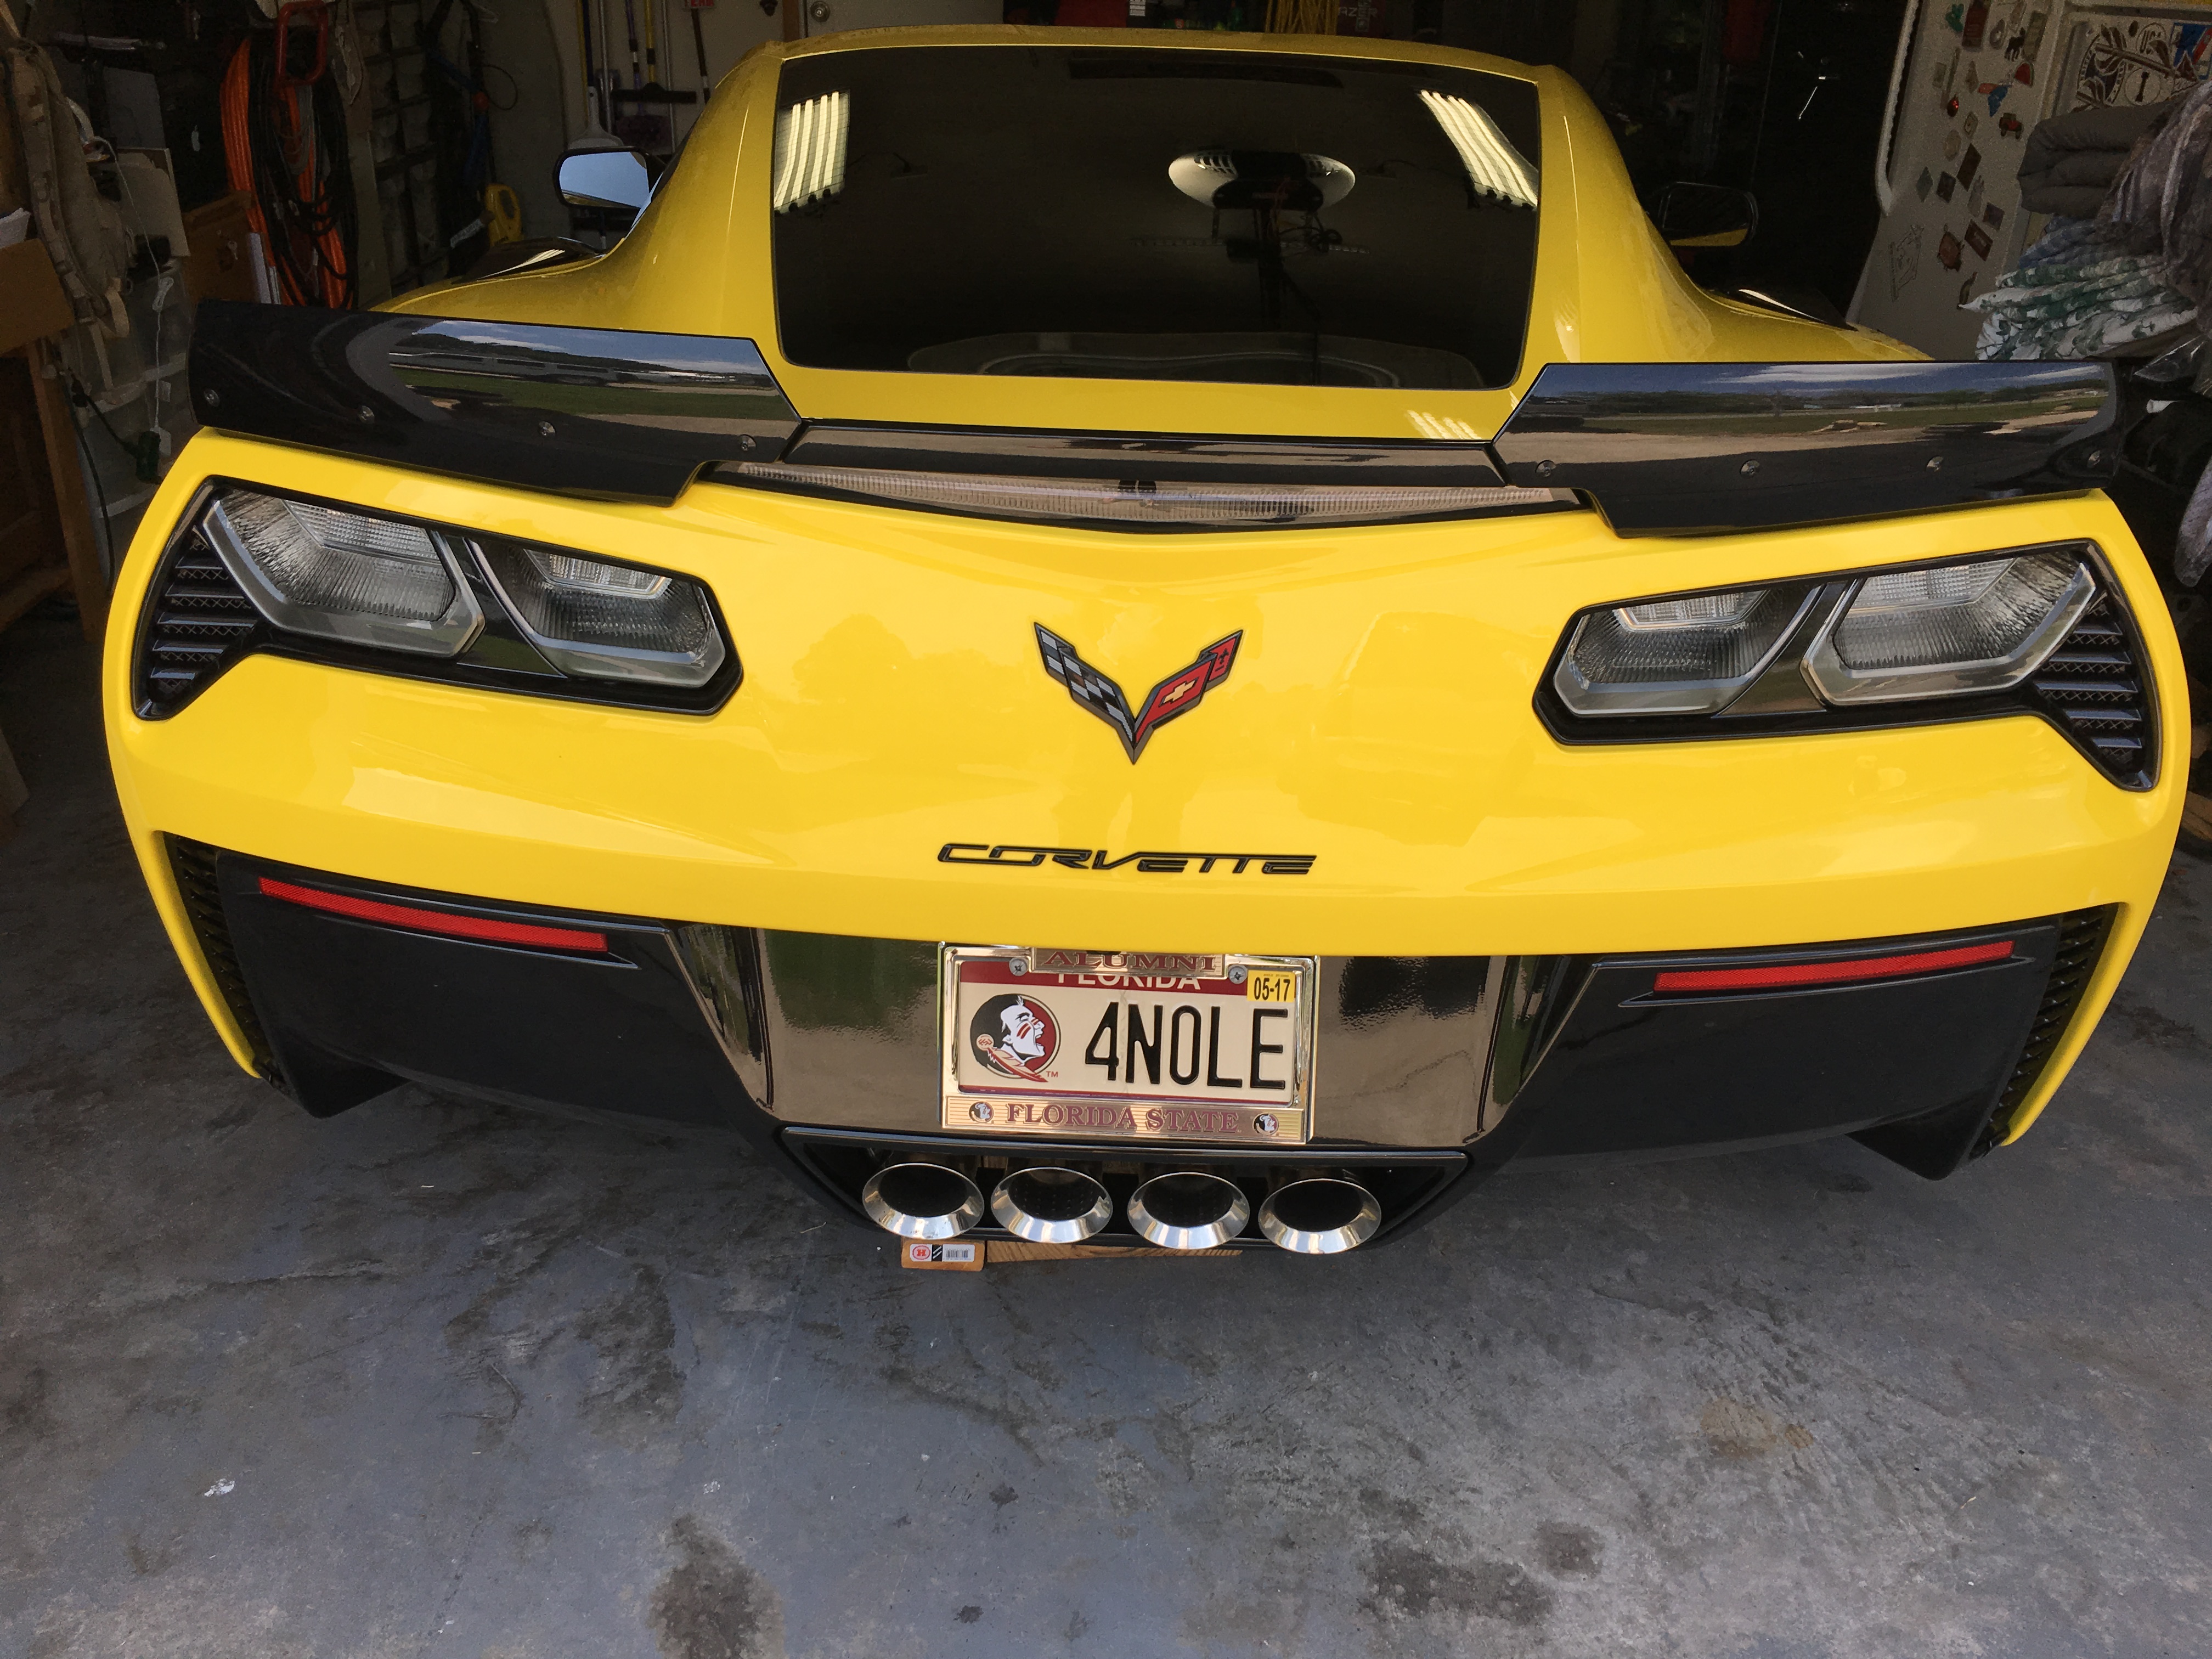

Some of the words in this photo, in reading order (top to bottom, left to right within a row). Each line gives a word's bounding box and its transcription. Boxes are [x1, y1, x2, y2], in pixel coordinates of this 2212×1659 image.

[1338, 7, 1378, 18] AZER
[938, 843, 1317, 875] CORVETTE
[1042, 950, 1217, 972] ALUMNI
[1254, 977, 1291, 1002] 05-17
[1085, 1002, 1288, 1090] 4NOLE
[1006, 1103, 1138, 1130] FLORIDA
[1146, 1108, 1239, 1133] STATE
